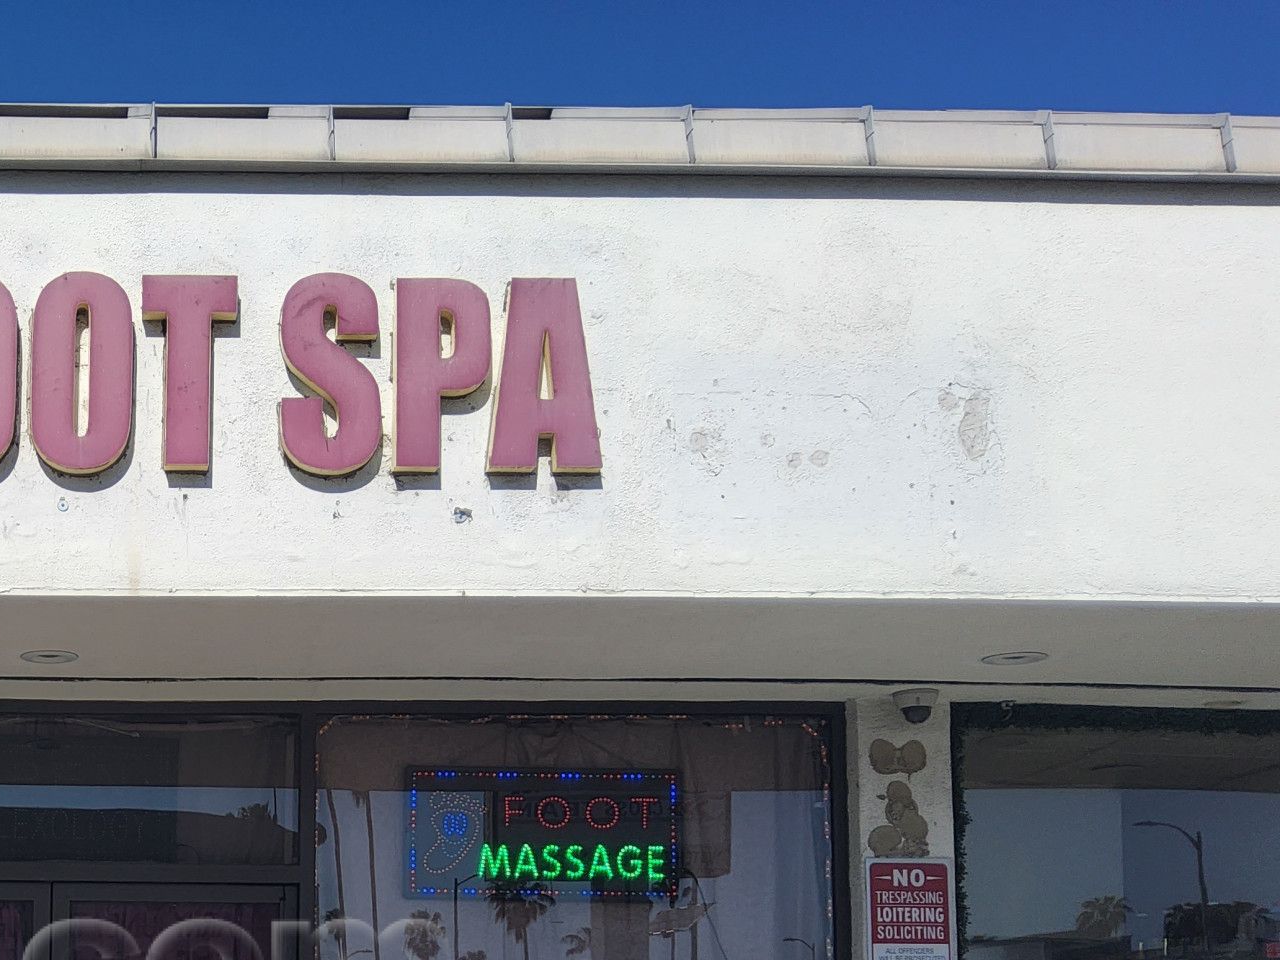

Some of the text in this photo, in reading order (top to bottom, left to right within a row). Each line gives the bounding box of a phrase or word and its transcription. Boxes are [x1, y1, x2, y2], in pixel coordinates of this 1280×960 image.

[278, 273, 603, 476] SPA
[504, 796, 658, 829] FOOT
[479, 843, 665, 879] MASSAGE
[893, 869, 925, 887] NO
[877, 891, 943, 903] TRESPASSING
[877, 907, 944, 923] LOITERING
[877, 925, 944, 939] SOLICITING
